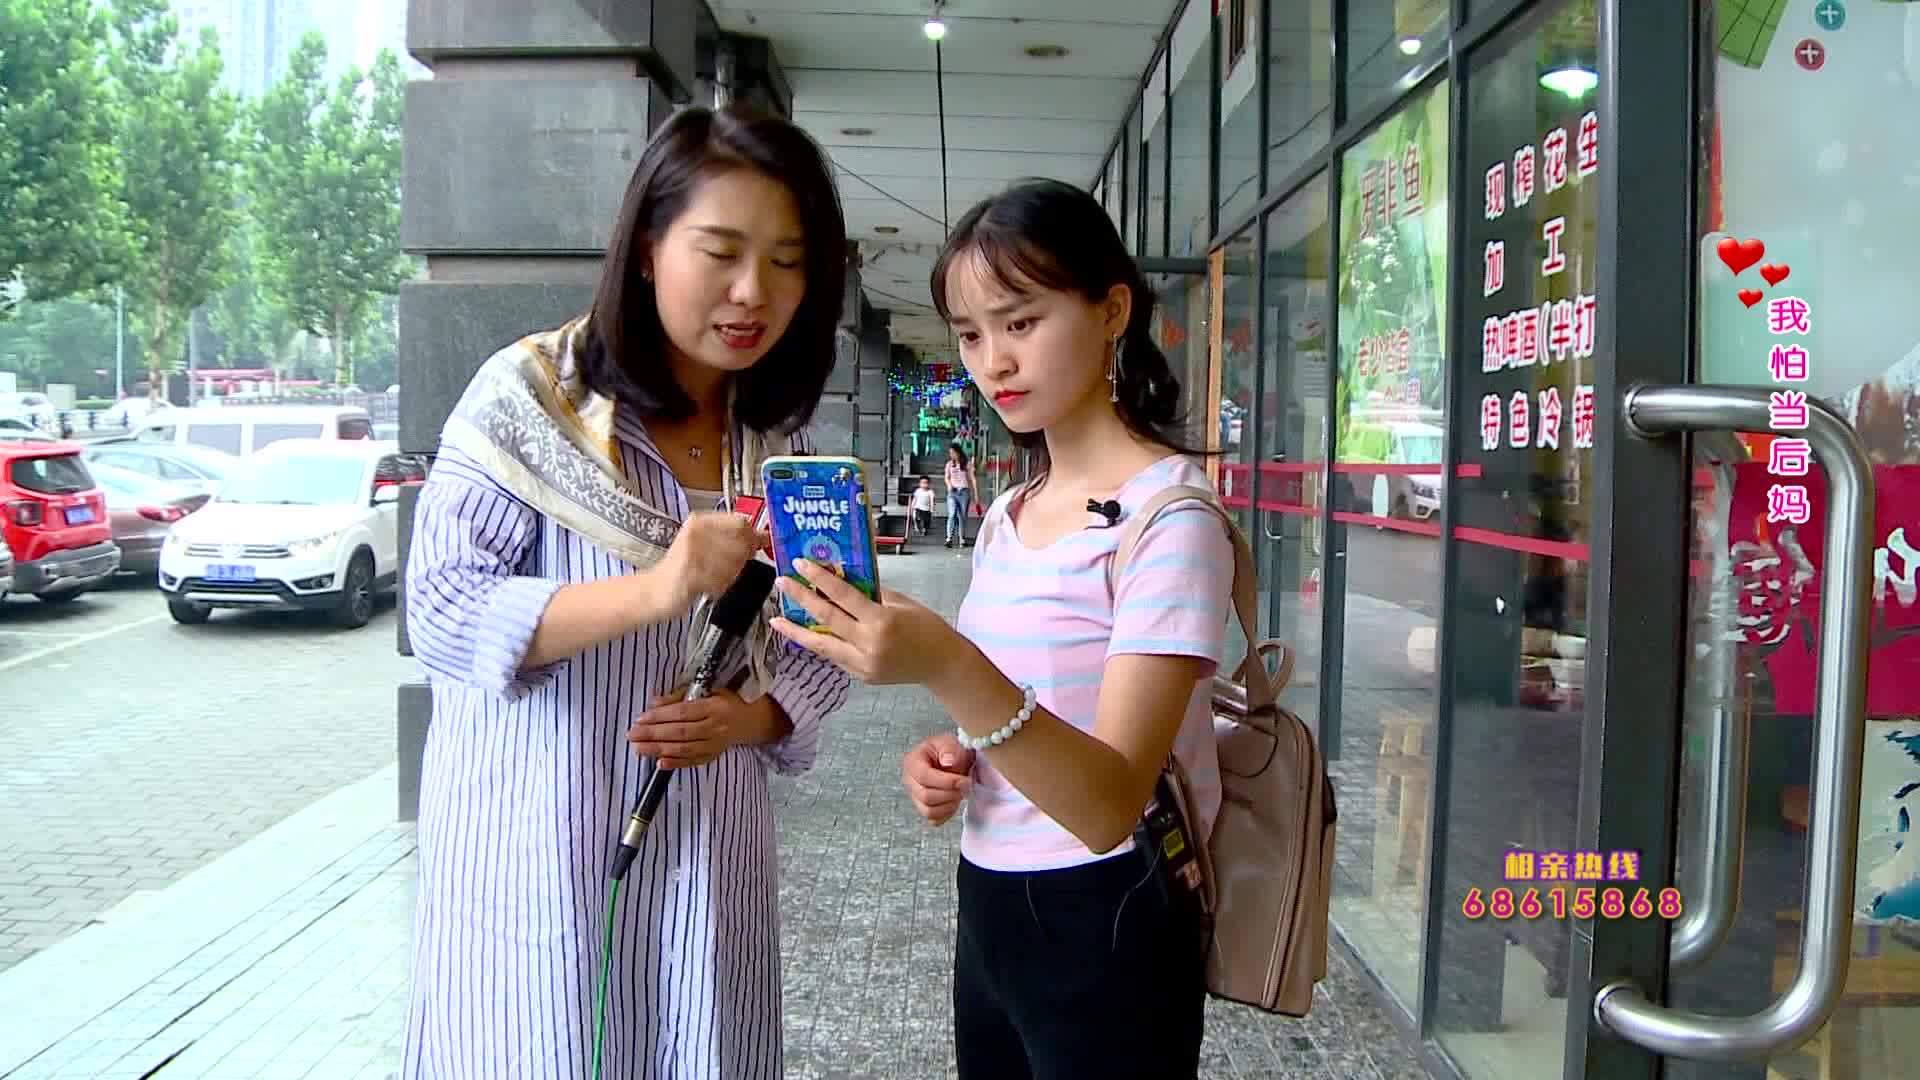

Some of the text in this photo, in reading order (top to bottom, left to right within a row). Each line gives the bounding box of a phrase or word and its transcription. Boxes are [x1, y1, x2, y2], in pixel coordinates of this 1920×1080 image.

[1485, 111, 1598, 220] 现榨花生
[1481, 385, 1594, 451] 特色冷锅
[783, 496, 849, 515] JUNGLE
[794, 513, 842, 532] PANG
